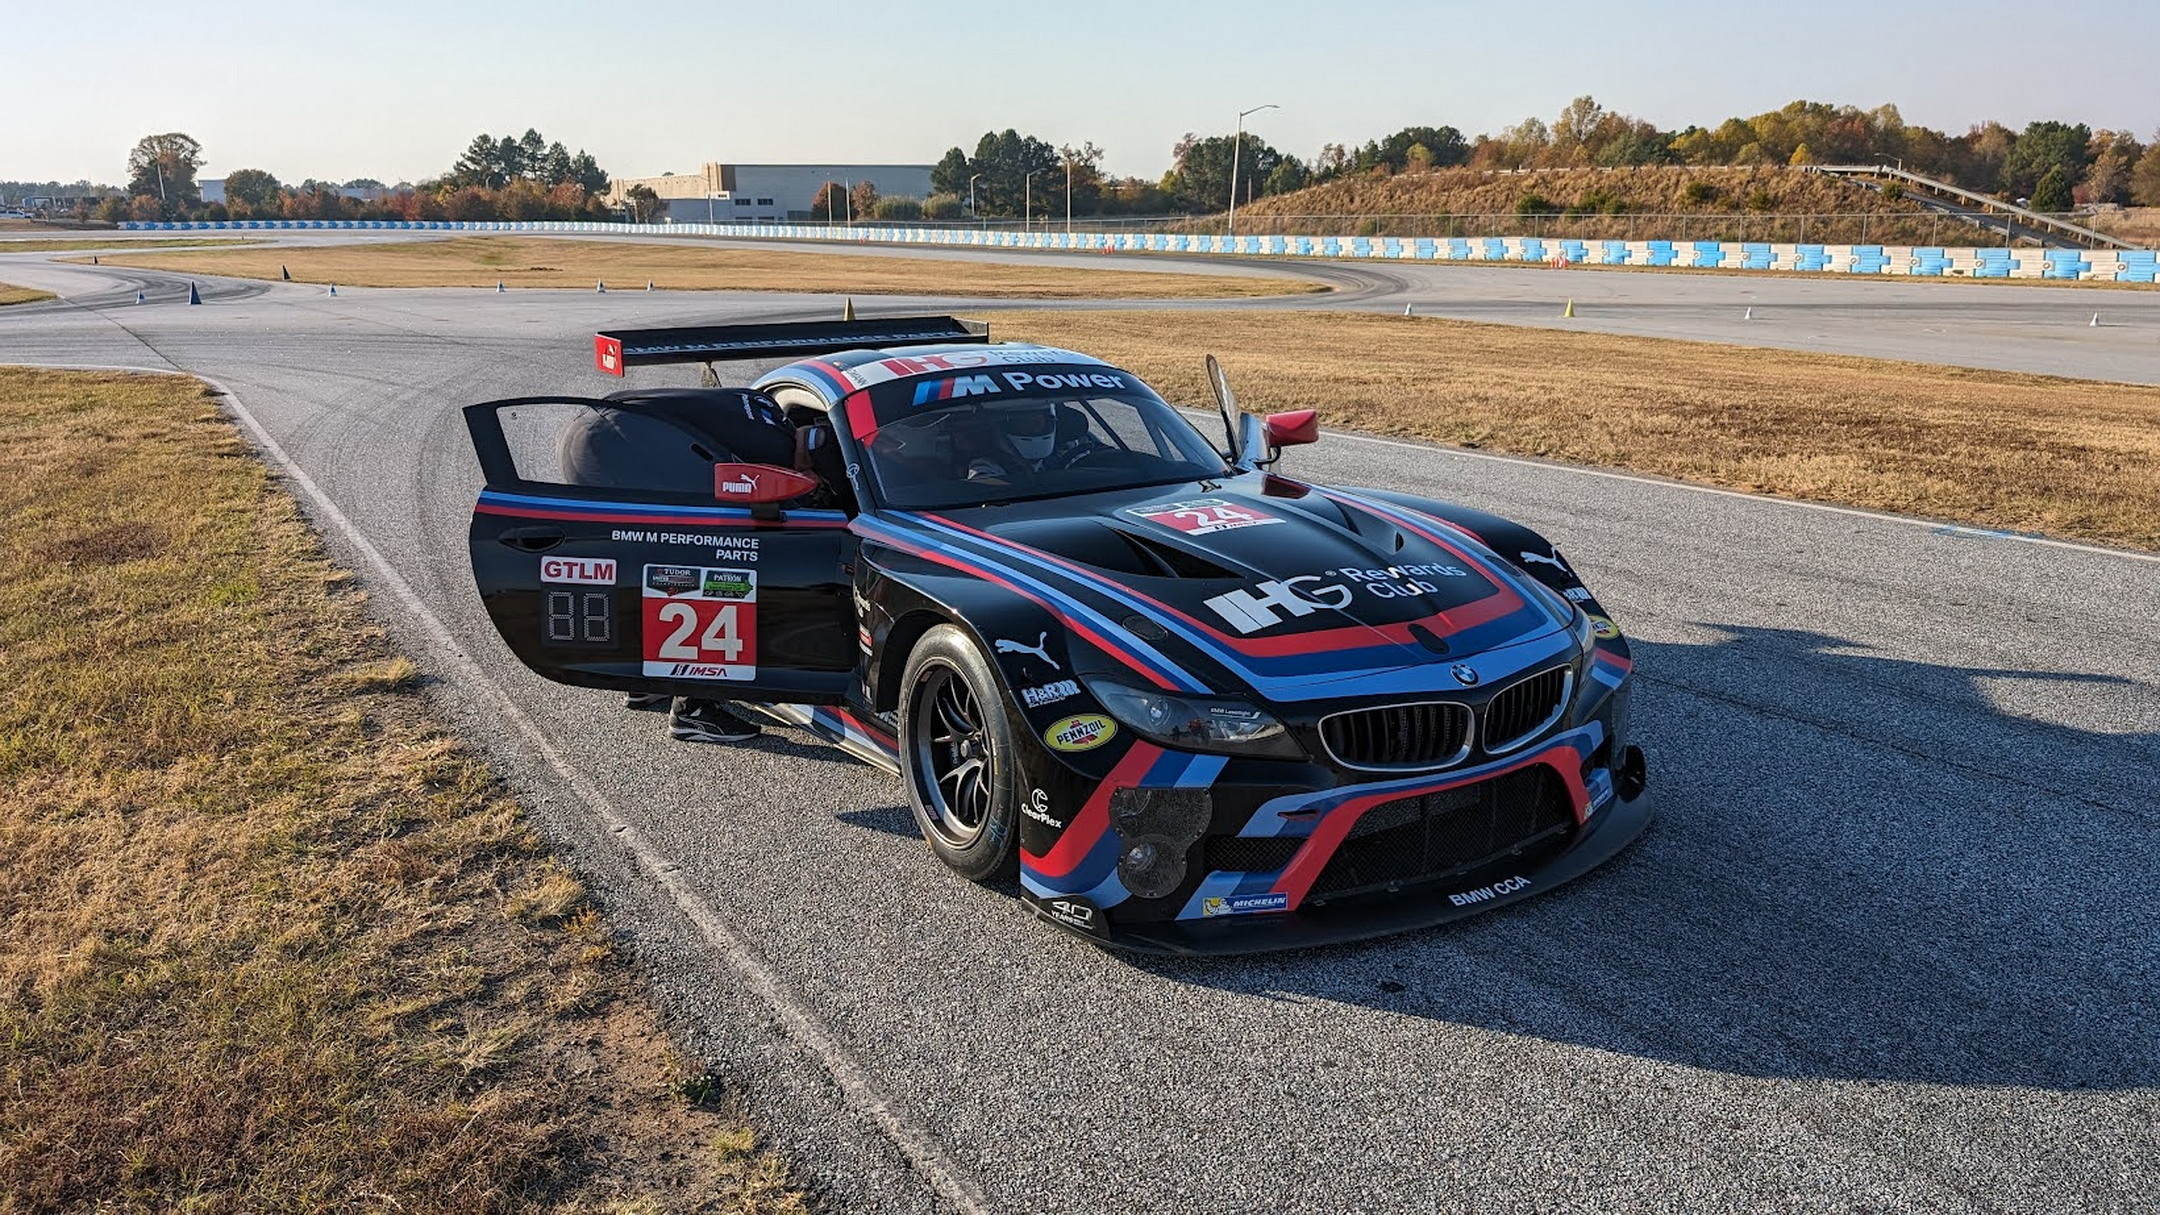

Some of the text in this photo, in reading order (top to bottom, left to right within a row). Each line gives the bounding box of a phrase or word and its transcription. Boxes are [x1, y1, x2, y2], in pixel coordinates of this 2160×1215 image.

[880, 351, 988, 376] IHG
[1002, 372, 1127, 394] Power
[722, 482, 751, 493] PUMA
[1174, 507, 1254, 527] 24
[612, 530, 759, 549] BMW M PERFORMANCE
[716, 549, 758, 561] PARTS
[544, 561, 613, 580] GTLM
[1339, 562, 1467, 583] Rewards
[1366, 577, 1439, 599] Club
[1203, 574, 1353, 635] IHG
[658, 602, 744, 662] 24
[1056, 719, 1106, 746] PENNZOIL
[1021, 803, 1062, 828] ClearPlex
[1449, 875, 1531, 906] BMW CCA
[1052, 901, 1093, 920] 40
[1233, 897, 1286, 908] MICHELIN
